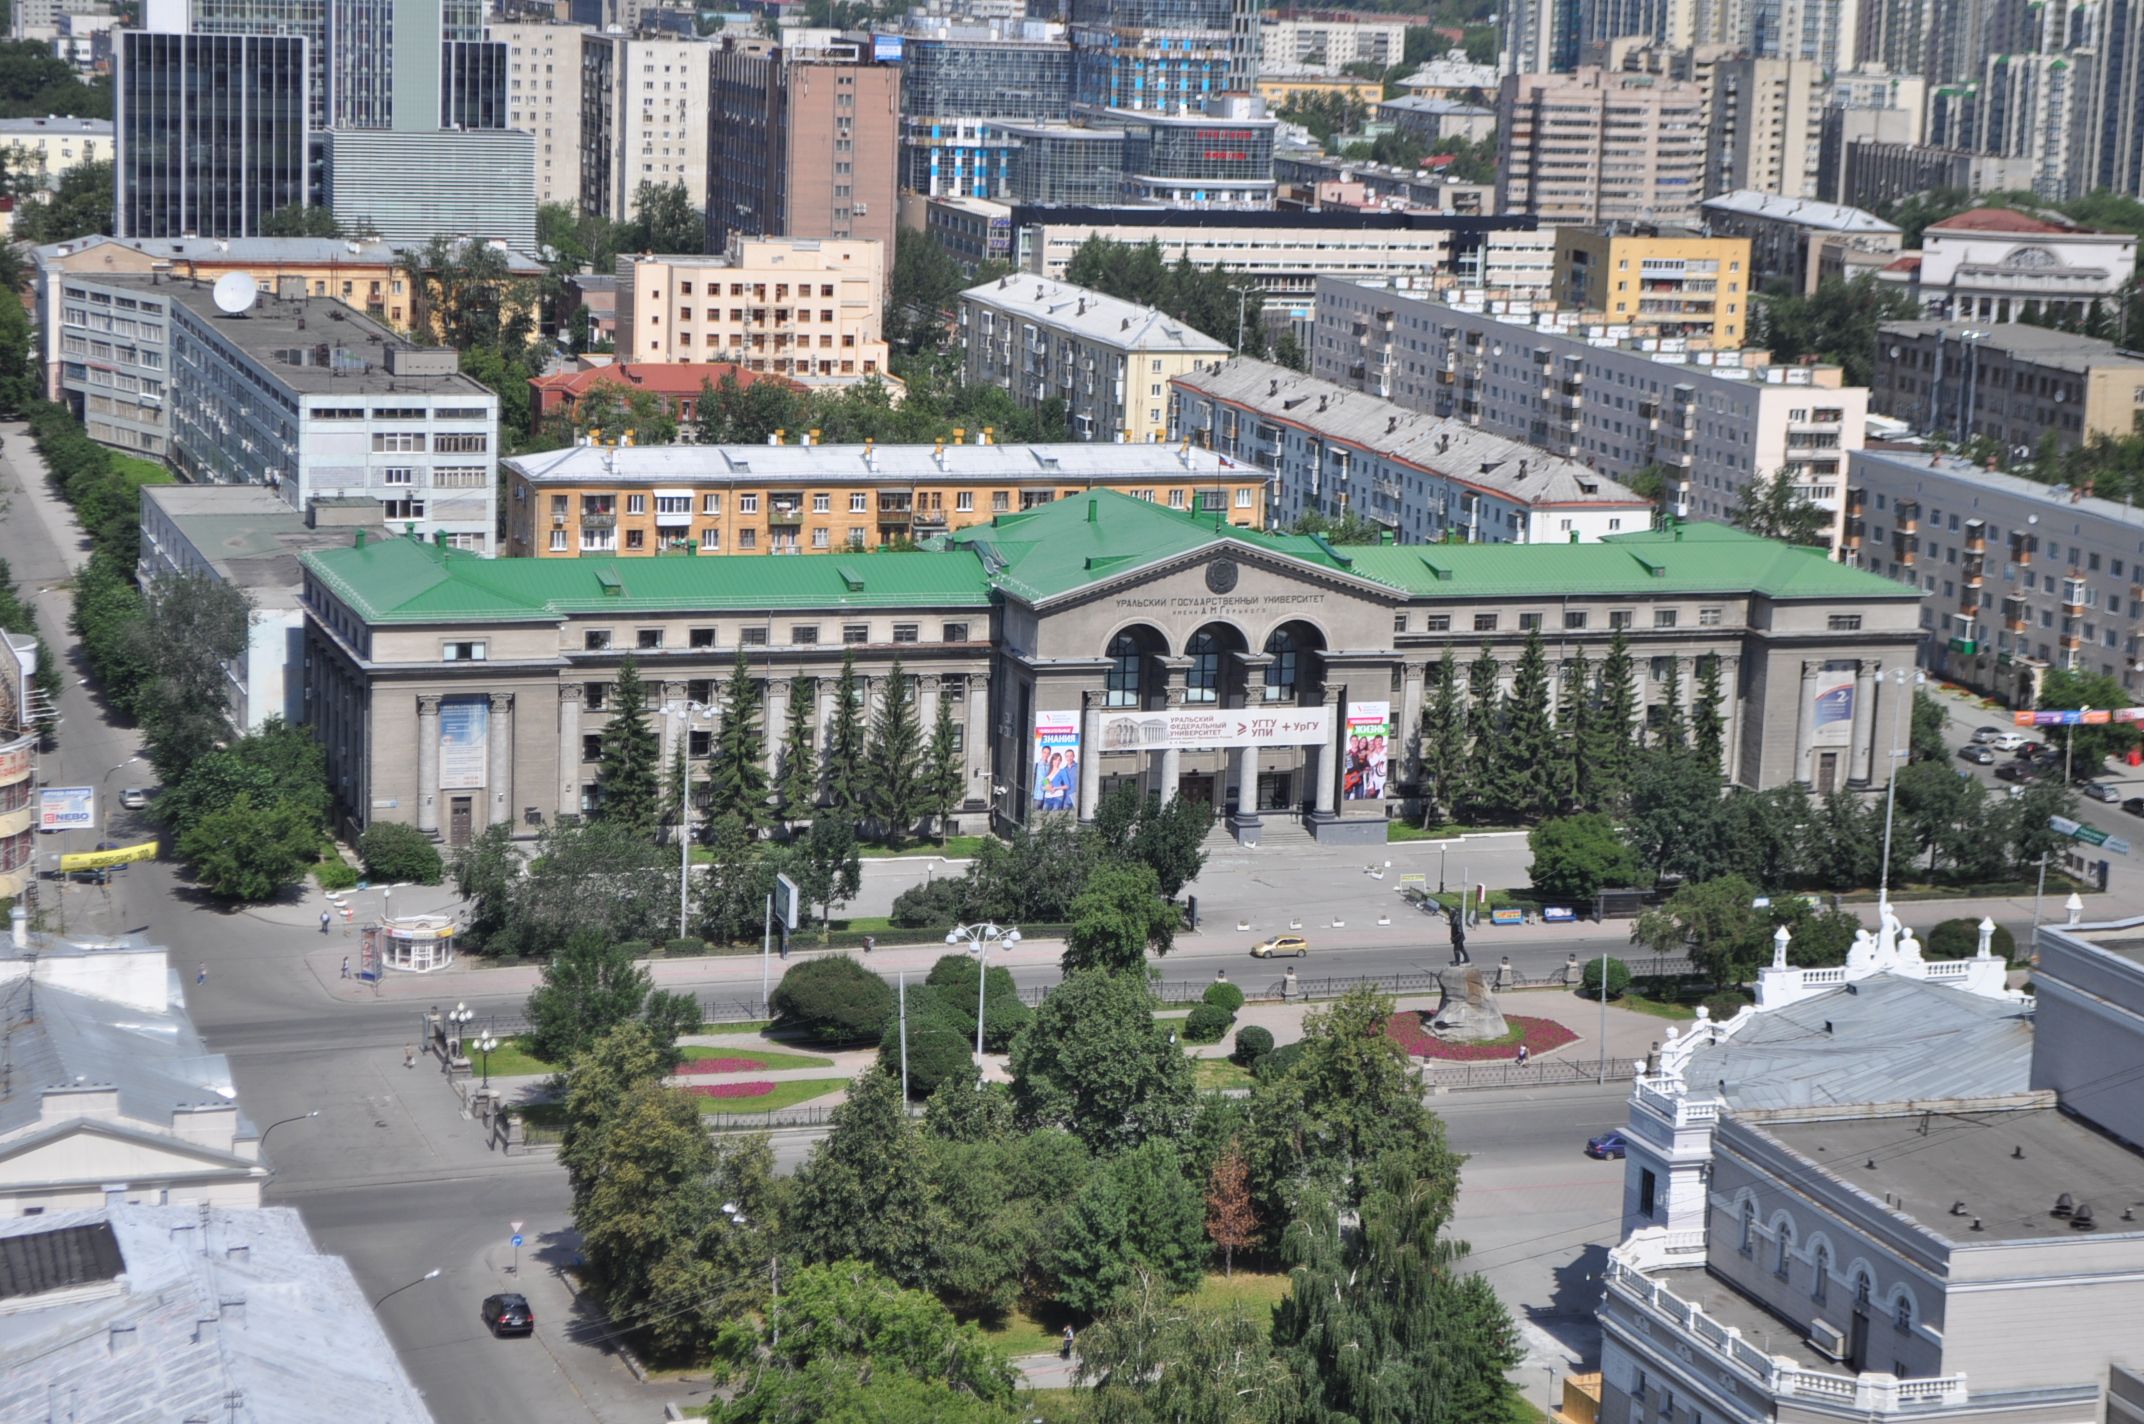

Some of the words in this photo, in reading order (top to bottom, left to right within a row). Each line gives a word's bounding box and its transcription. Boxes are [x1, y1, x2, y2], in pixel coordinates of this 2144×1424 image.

[1116, 598, 1167, 607] УРАЛЬСКИЙ
[1171, 595, 1259, 607] ГОСУДАРСТВЕННЫЙ
[1263, 594, 1325, 604] УНИВЕРСИТЕТ
[1170, 722, 1227, 730] ФЕДЕРАЛЬНЫЙ
[1252, 719, 1278, 728] УГТУ
[1293, 721, 1319, 732] УрГУ
[1355, 724, 1386, 734] ЖИЗНЬ
[1251, 728, 1273, 738] УПИ
[1042, 734, 1076, 744] ЗНАНИЯ
[56, 812, 89, 820] NEBO
